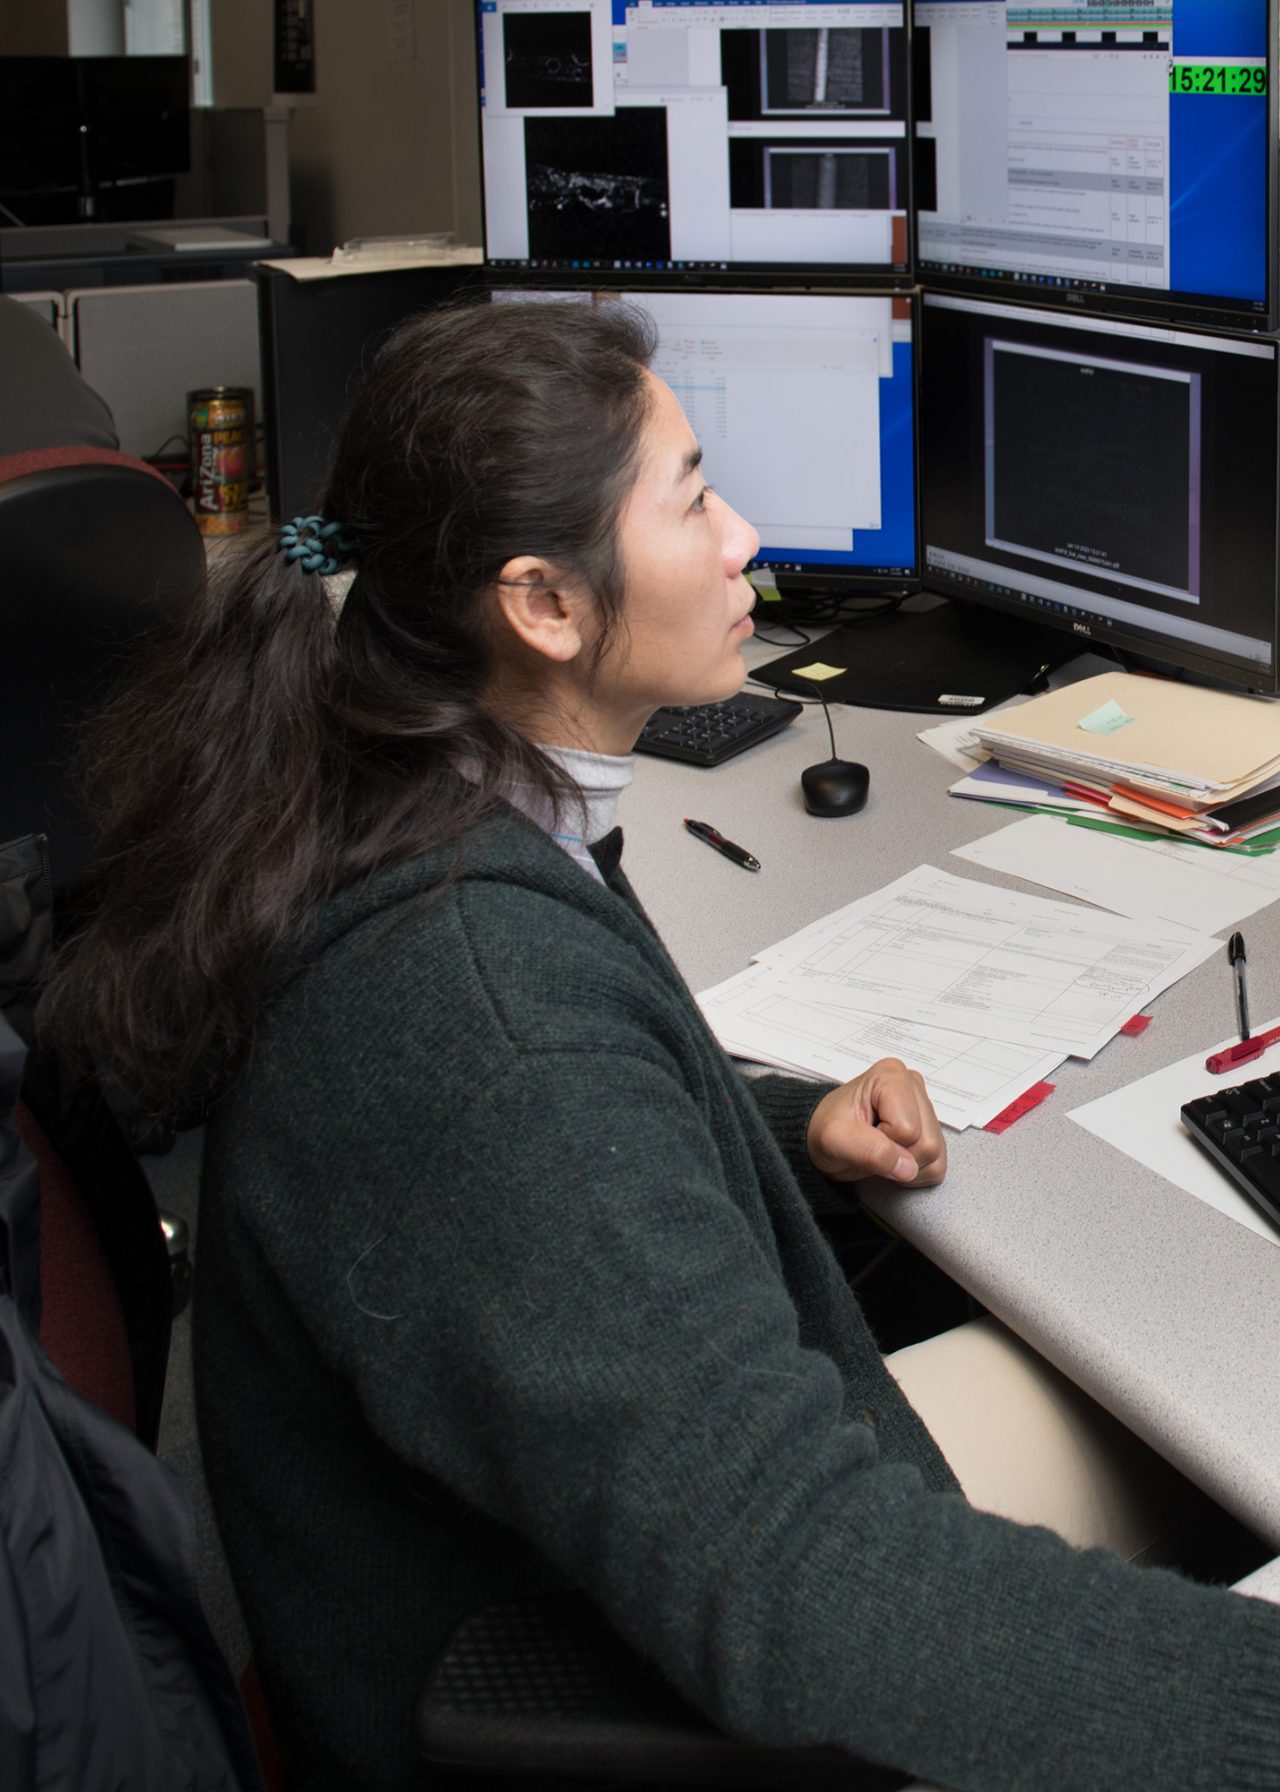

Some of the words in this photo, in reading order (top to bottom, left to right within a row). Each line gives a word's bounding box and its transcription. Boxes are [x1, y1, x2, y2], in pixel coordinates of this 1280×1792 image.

[1170, 66, 1266, 94] 15:21:29
[199, 432, 219, 512] AriZona
[1073, 622, 1092, 636] DELL
